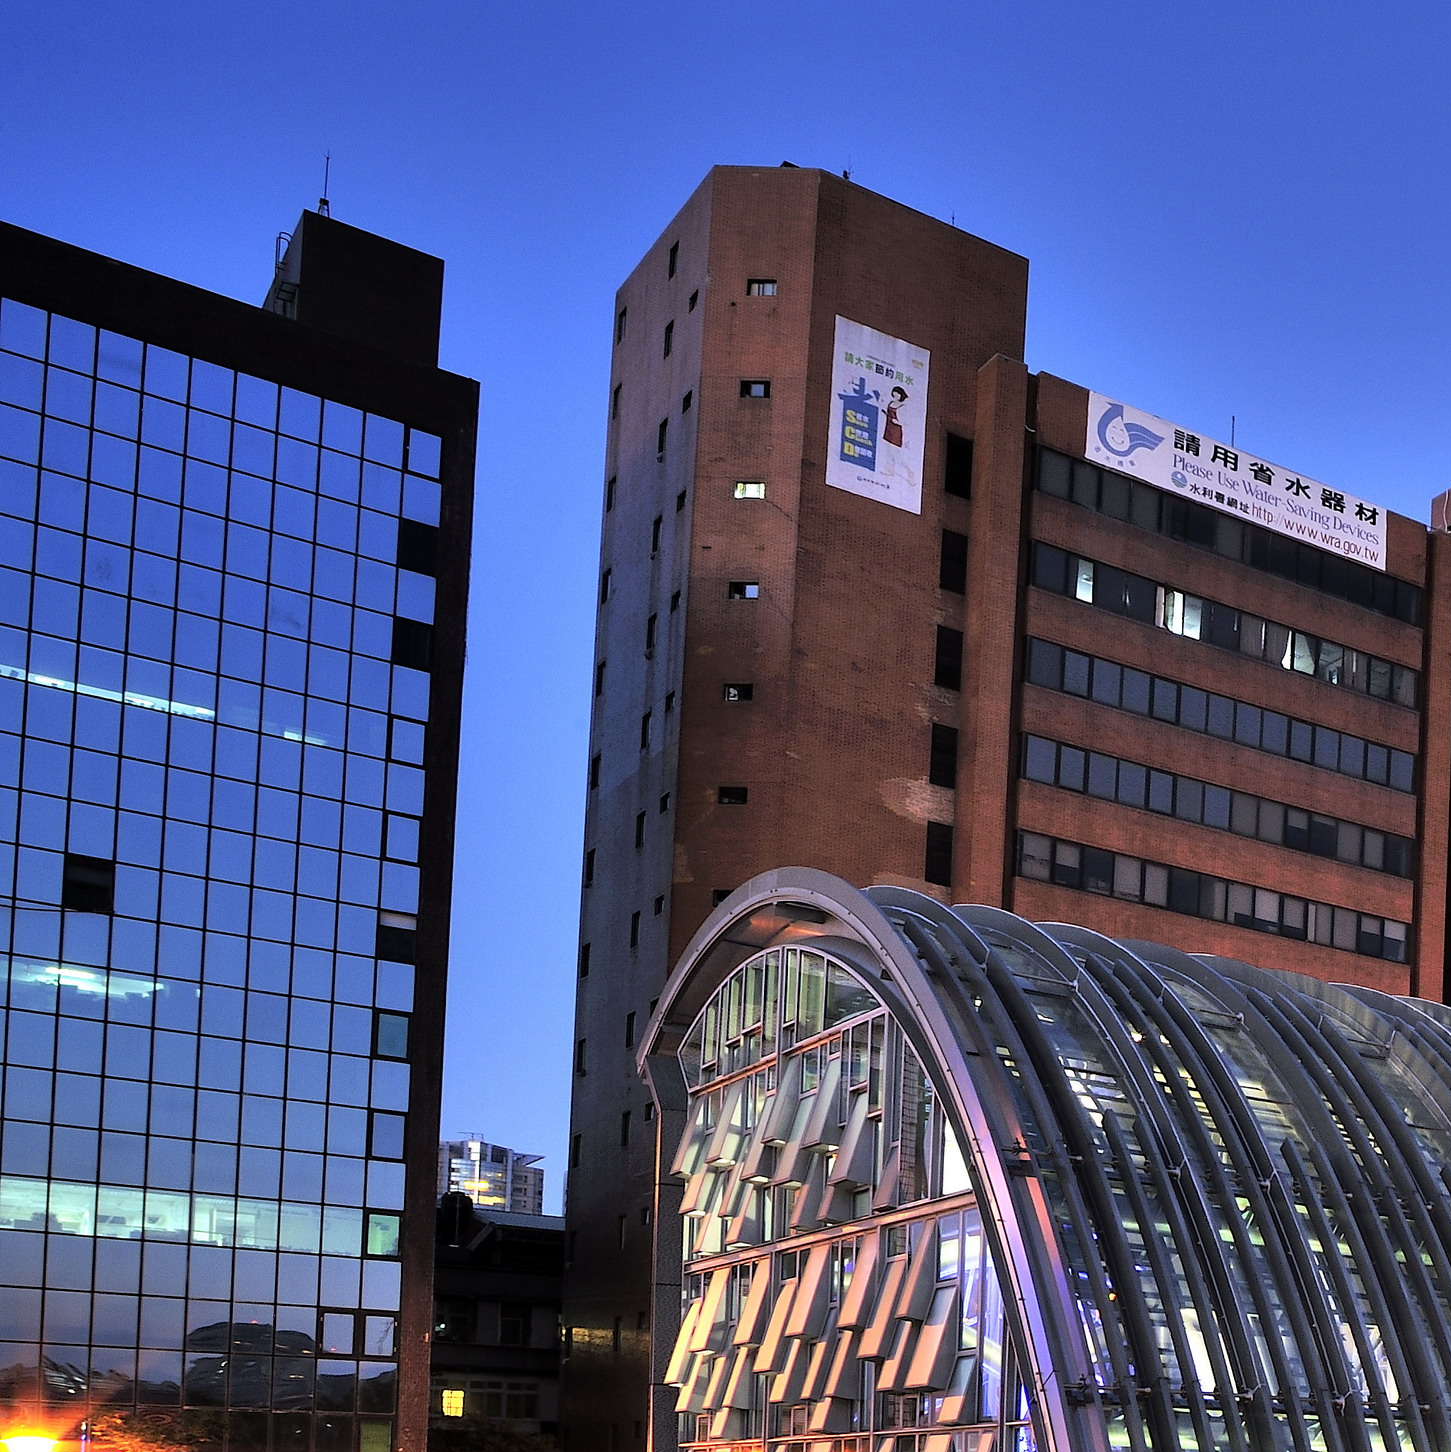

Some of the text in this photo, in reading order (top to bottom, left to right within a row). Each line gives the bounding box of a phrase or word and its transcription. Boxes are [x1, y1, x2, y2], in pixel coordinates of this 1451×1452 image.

[845, 352, 914, 386] 請大家節約用水
[1173, 428, 1379, 526] 請用省水器材
[1173, 453, 1379, 546] Please Use Water-Saving Devices
[1189, 483, 1379, 562] 水利署網址 http://www.wra.gov.tw
